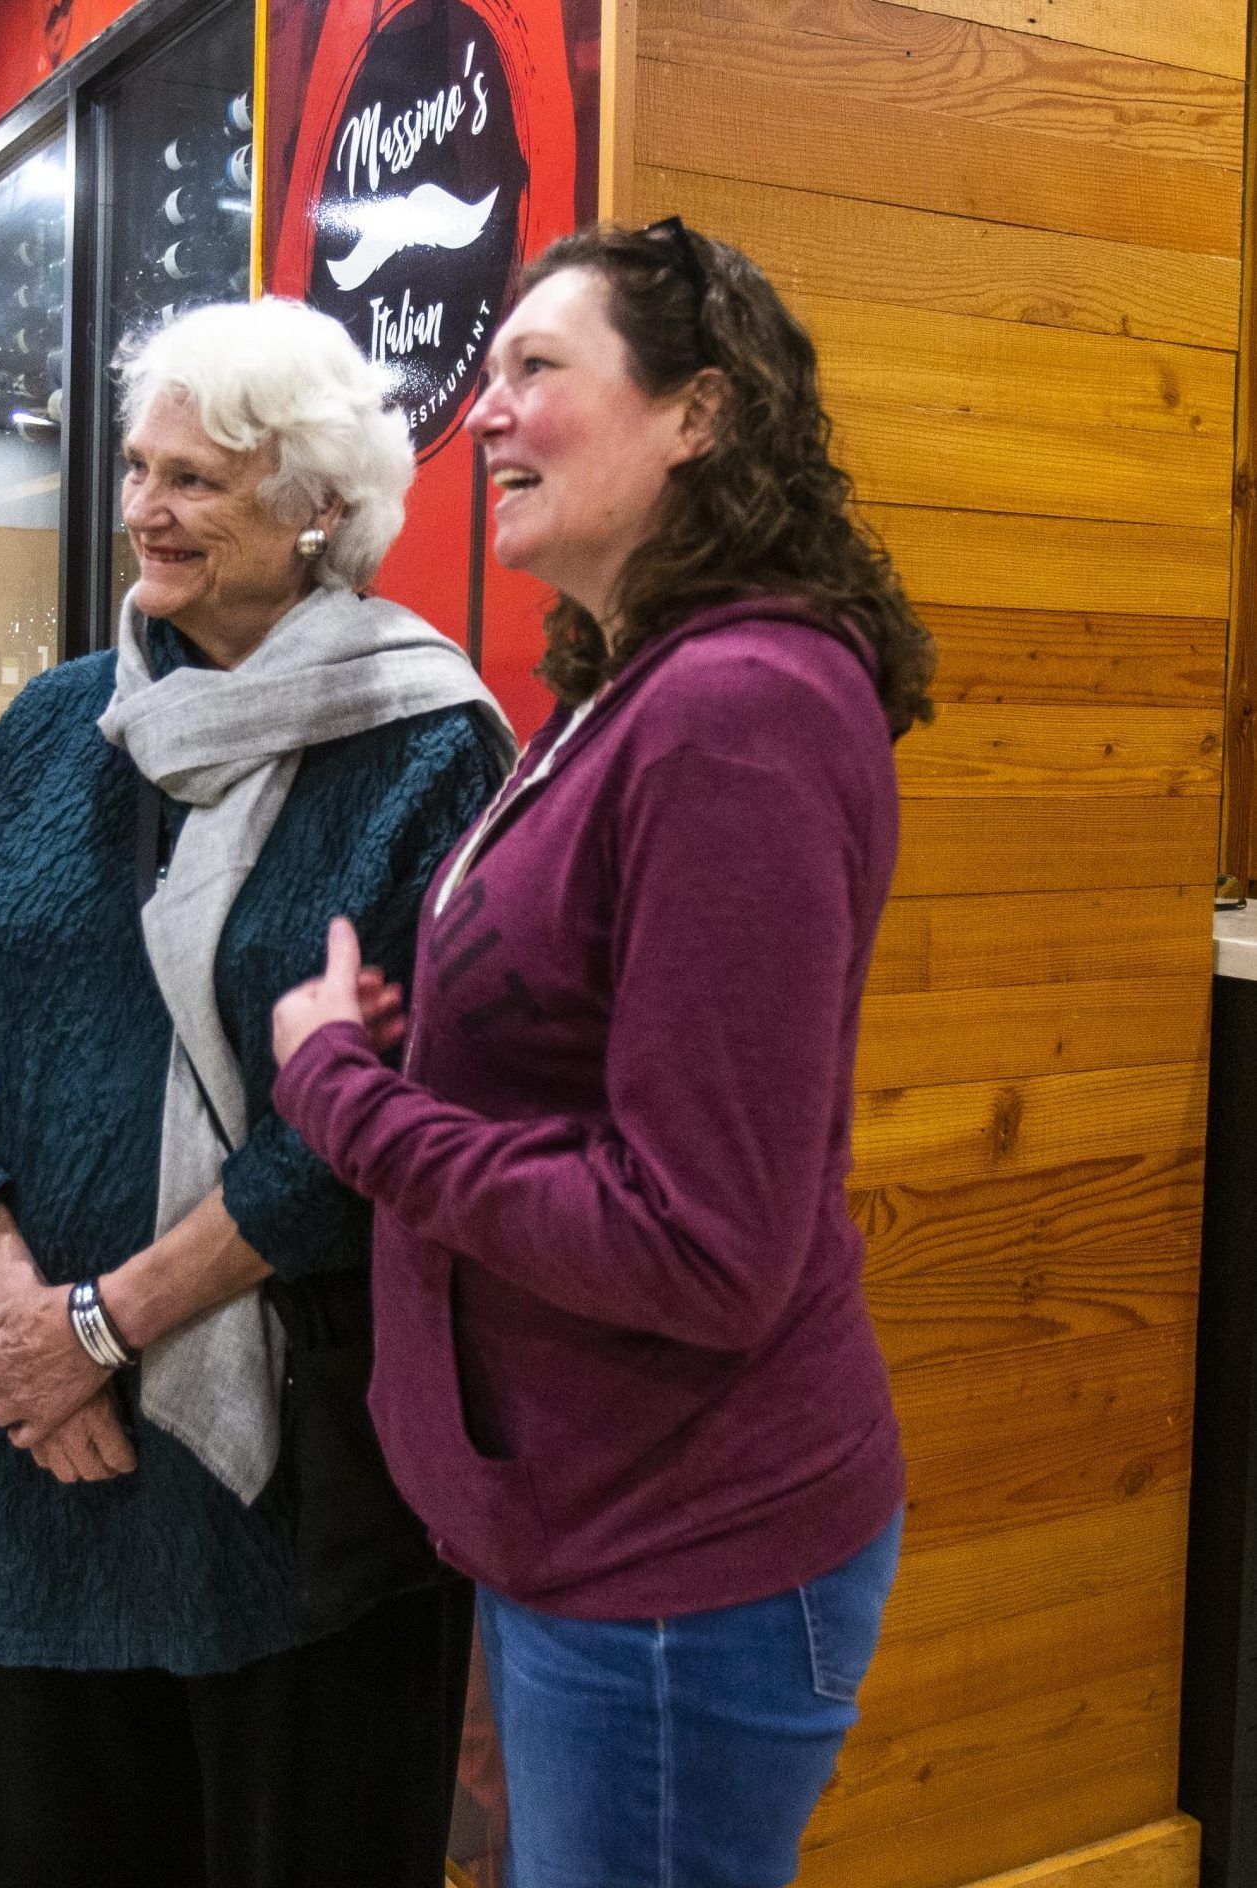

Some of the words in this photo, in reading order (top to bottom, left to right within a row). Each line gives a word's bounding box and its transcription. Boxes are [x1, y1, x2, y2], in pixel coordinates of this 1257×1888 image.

[337, 41, 489, 195] Massimo's
[369, 288, 443, 364] Italian
[410, 299, 490, 429] ESTAURANT
